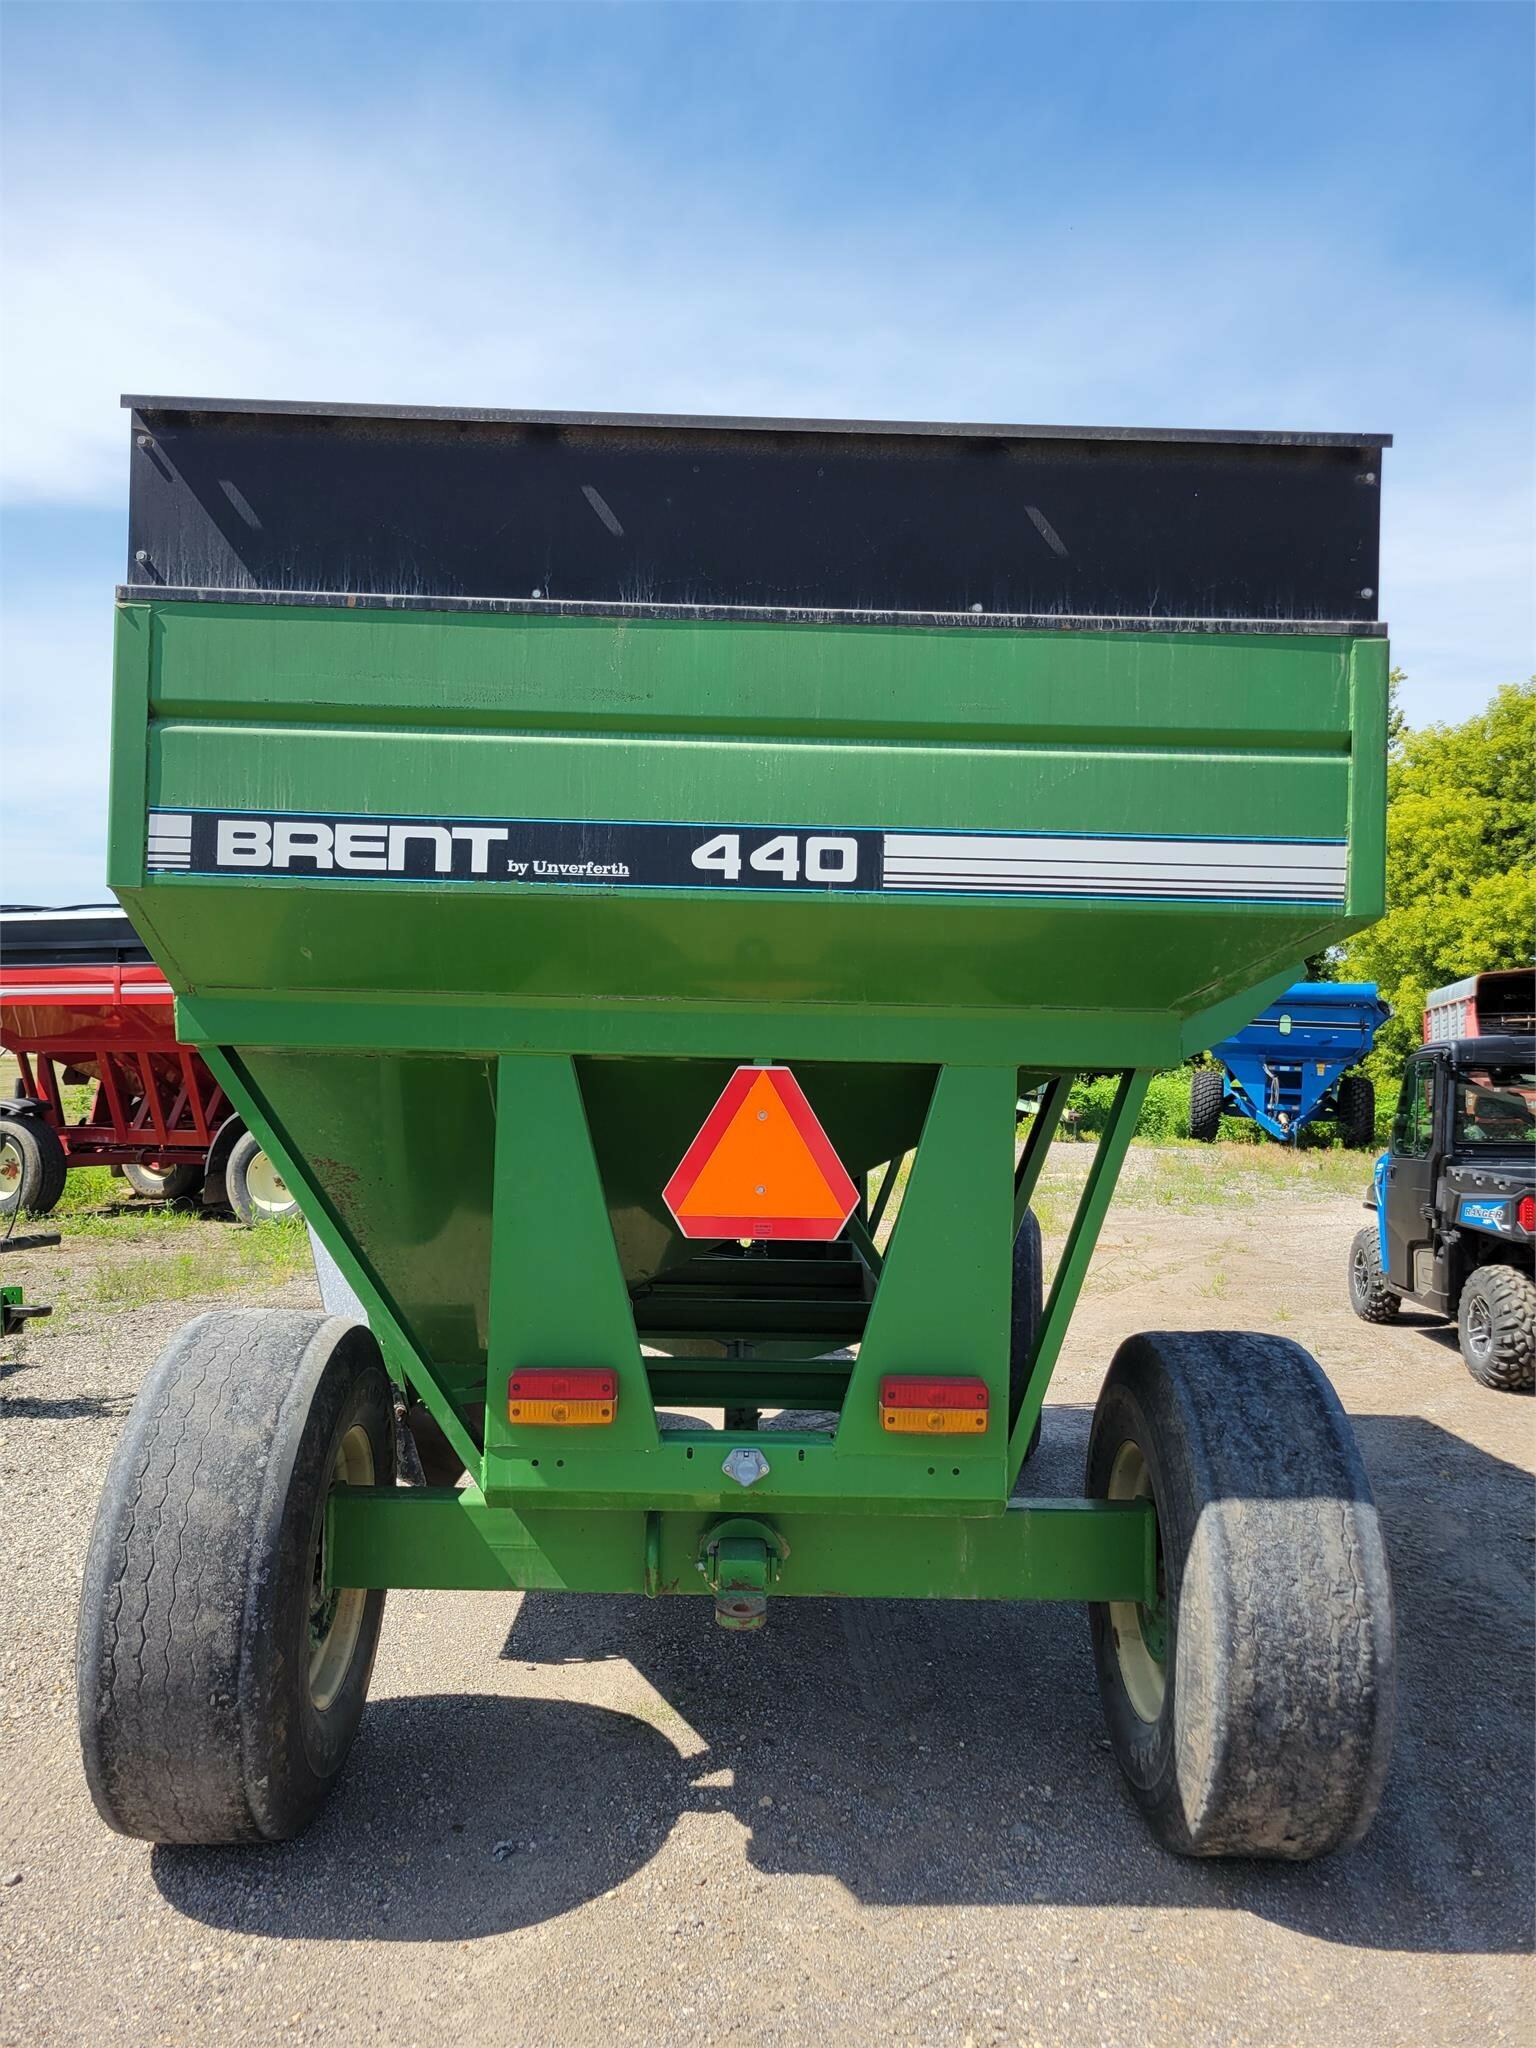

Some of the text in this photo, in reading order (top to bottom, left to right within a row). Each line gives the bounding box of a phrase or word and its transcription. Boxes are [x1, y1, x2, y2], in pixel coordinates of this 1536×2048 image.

[216, 819, 508, 873] BRENT
[691, 834, 858, 882] 440
[507, 859, 629, 877] by Unverferth
[1464, 1206, 1504, 1219] RANGER
